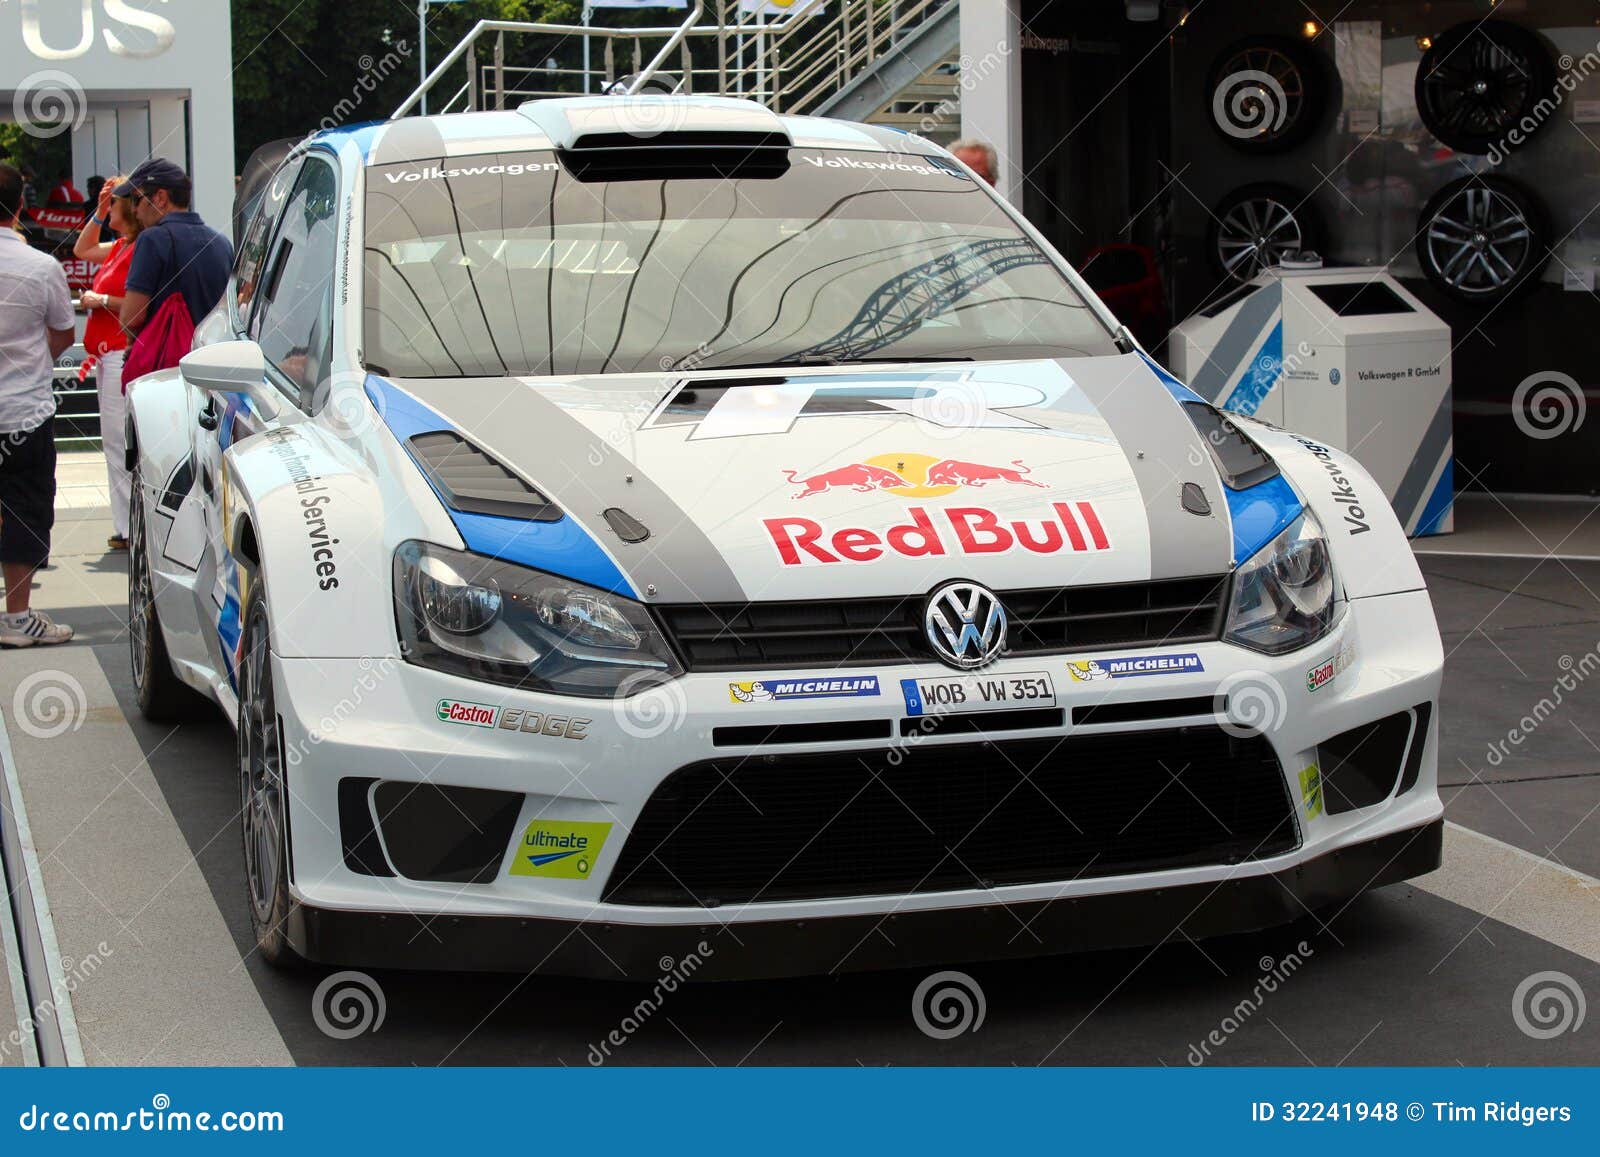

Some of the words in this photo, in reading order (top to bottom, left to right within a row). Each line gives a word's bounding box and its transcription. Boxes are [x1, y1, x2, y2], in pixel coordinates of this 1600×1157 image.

[1018, 28, 1070, 56] olkswagen
[384, 163, 560, 184] Volkswagen
[803, 156, 957, 176] Volkswagen
[1358, 370, 1406, 382] Volkswagen
[1415, 367, 1441, 378] GmbH
[300, 495, 340, 591] Services
[762, 506, 948, 566] Red
[943, 501, 1111, 554] Bull
[1110, 657, 1198, 672] MICHELIN
[775, 679, 876, 694] MICHELIN
[920, 683, 966, 705] WOB
[977, 680, 1007, 702] VW
[1009, 678, 1053, 700] 351
[910, 699, 917, 708] D
[450, 703, 495, 725] Castrol
[498, 707, 593, 741] EDGE
[525, 831, 588, 849] ultimate
